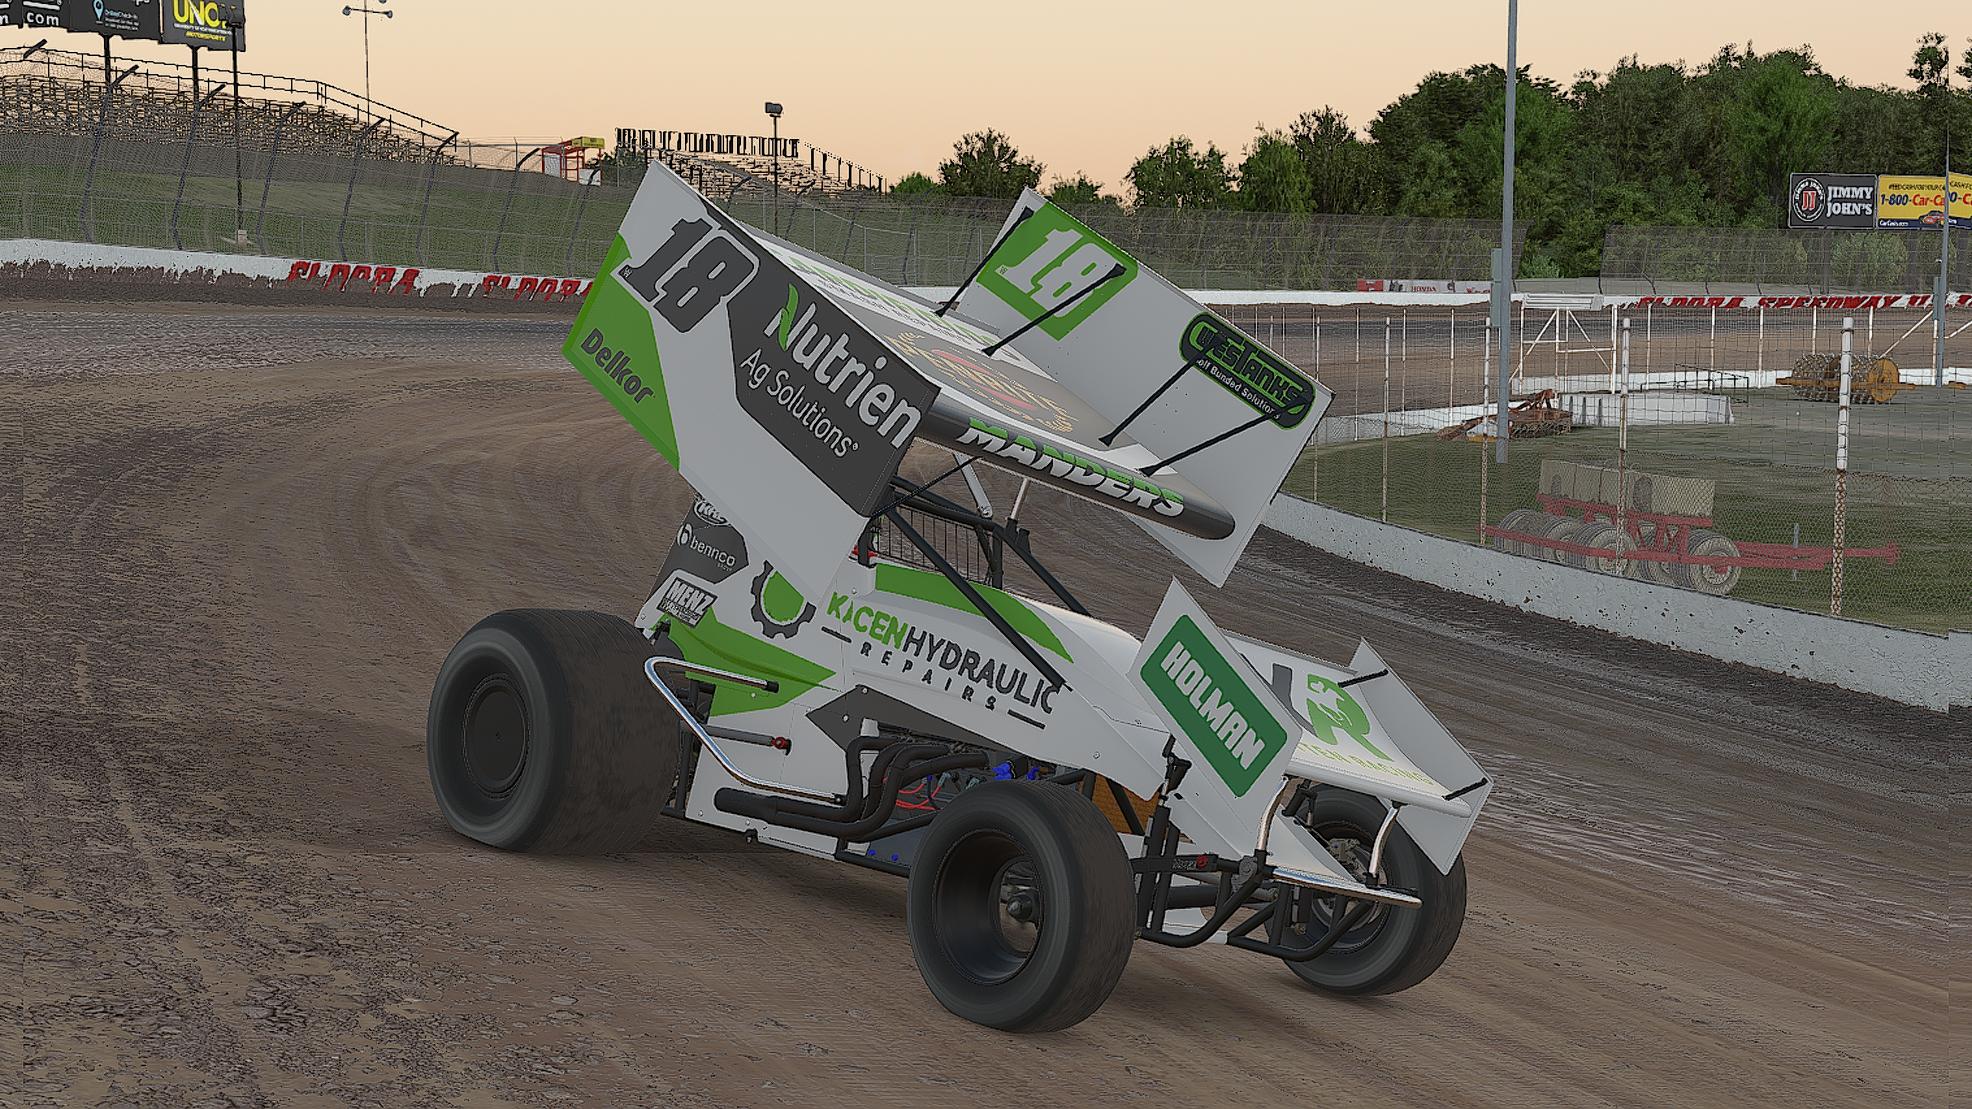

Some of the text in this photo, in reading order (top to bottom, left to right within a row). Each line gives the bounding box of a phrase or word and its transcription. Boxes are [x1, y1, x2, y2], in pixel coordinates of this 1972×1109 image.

[1826, 202, 1873, 218] JOHN'S
[1827, 186, 1874, 201] JIMMY
[482, 273, 594, 302] ELDOR
[617, 218, 757, 334] 18
[995, 229, 1123, 318] 18
[580, 327, 655, 404] Delkor
[740, 349, 771, 389] Ag
[764, 284, 923, 449] Nutrien
[1210, 366, 1242, 392] Bunded
[956, 417, 1185, 517] MANDERS
[690, 536, 736, 567] bennco
[666, 580, 714, 616] MENZ
[860, 641, 997, 711] REPAIRS
[1160, 641, 1266, 770] HOLMAN
